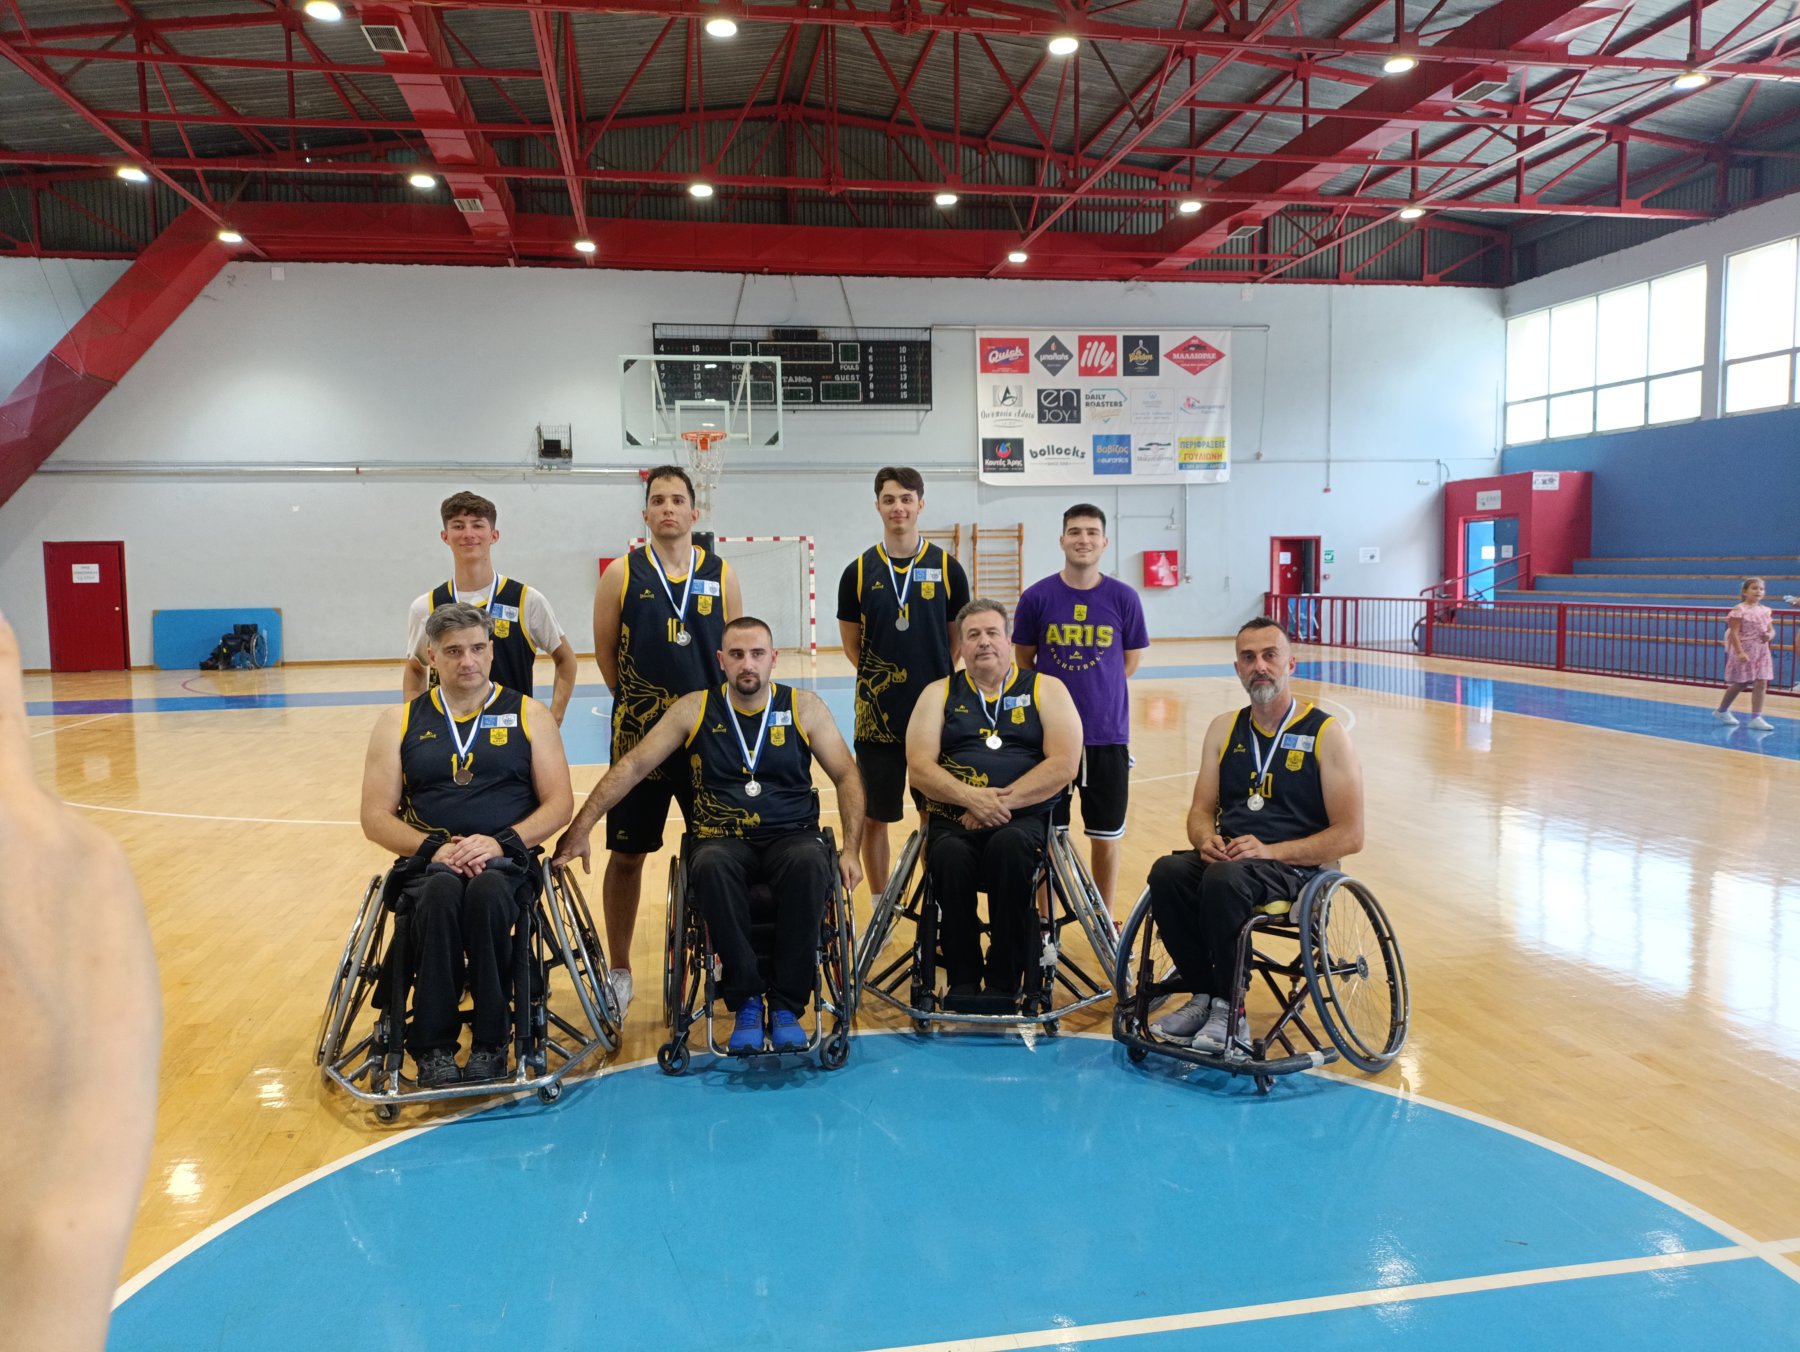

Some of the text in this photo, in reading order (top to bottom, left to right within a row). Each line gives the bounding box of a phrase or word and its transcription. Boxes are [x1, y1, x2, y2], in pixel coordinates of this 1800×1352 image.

[659, 344, 665, 352] 4
[691, 344, 700, 352] 10
[988, 346, 1024, 364] Quick
[1080, 341, 1115, 373] illy
[899, 364, 907, 372] 12
[868, 373, 873, 381] 7
[900, 373, 907, 381] 13
[900, 382, 908, 390] 14
[694, 391, 702, 399] 15
[900, 391, 908, 399] 15
[1040, 389, 1078, 408] en
[1041, 409, 1071, 423] JOY
[1029, 444, 1086, 459] bollocks
[1183, 452, 1223, 461] ΓΟΥΛΙΩΝΗ
[1046, 623, 1114, 648] ARIS
